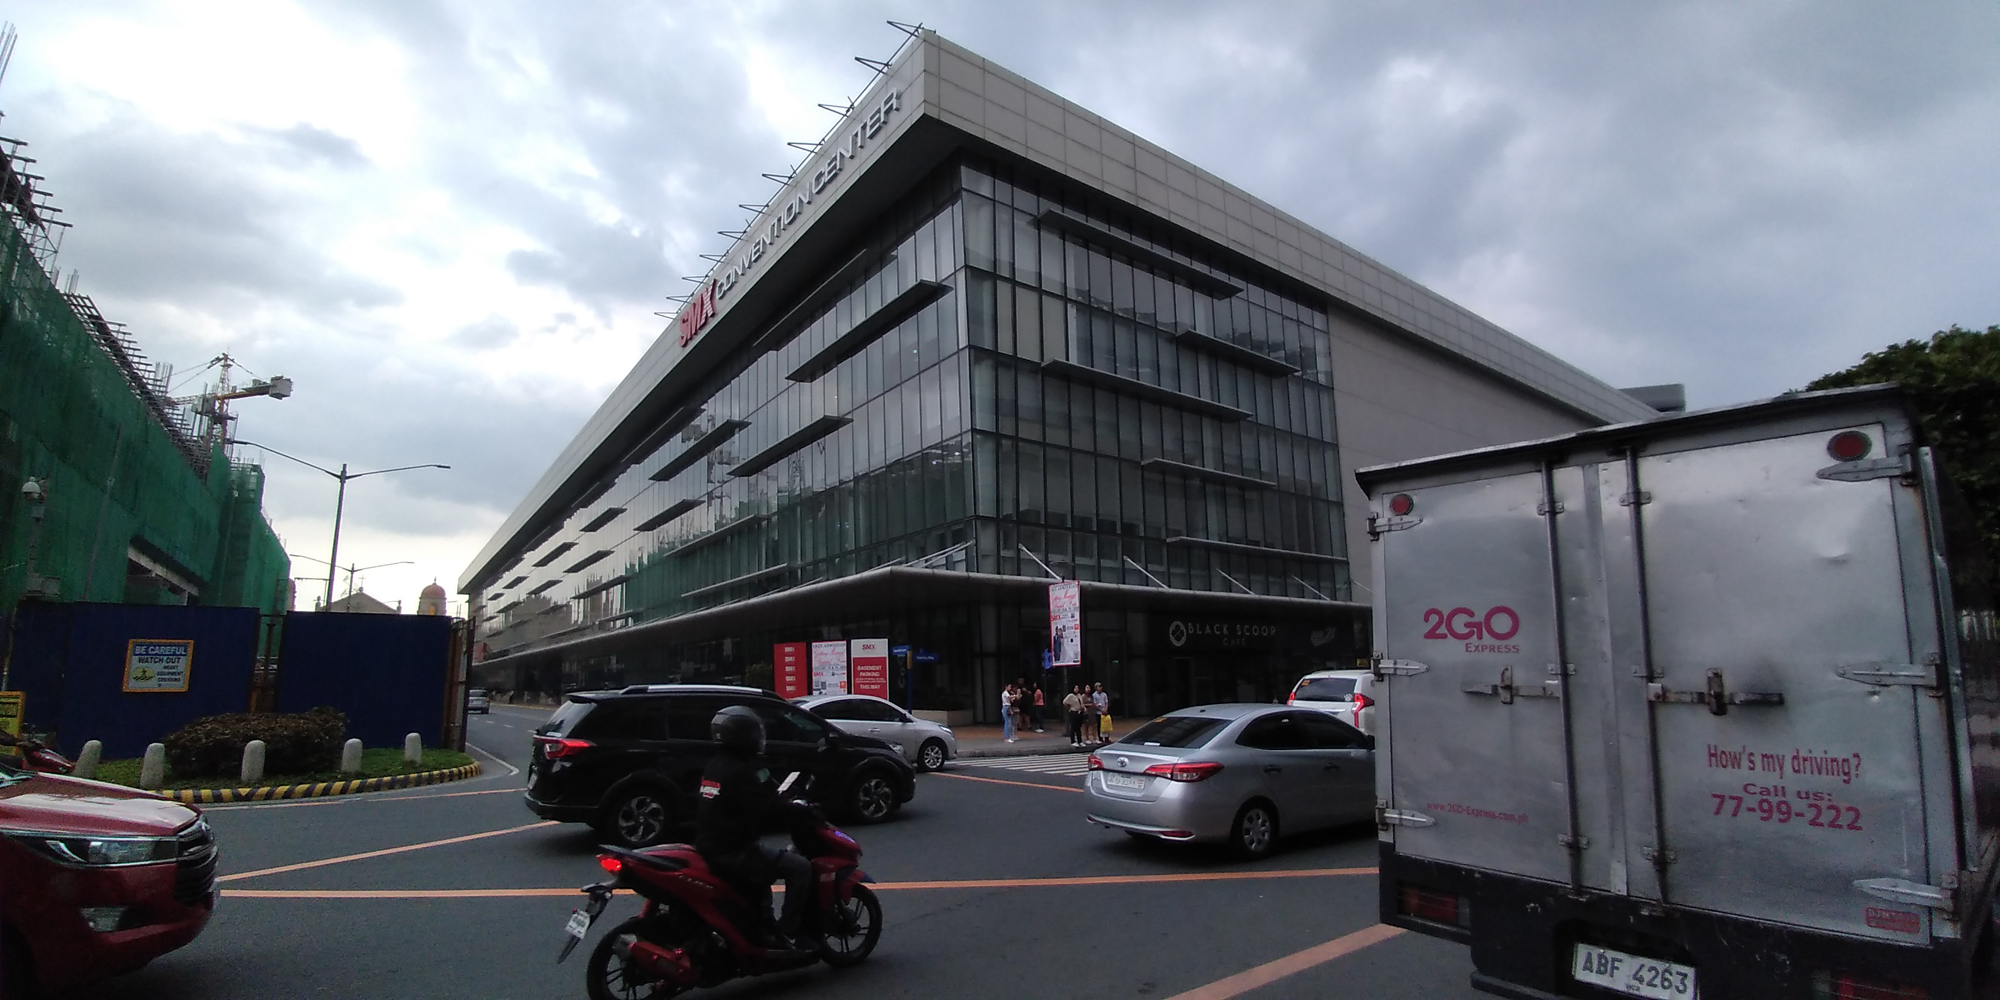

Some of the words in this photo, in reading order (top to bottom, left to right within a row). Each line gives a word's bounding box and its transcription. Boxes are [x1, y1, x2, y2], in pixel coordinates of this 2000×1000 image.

[678, 278, 718, 347] SMX
[716, 182, 812, 300] CONVENTION
[811, 87, 901, 196] CENTER
[1187, 622, 1229, 635] BLACK
[1236, 624, 1276, 636] SCOOP
[1423, 605, 1520, 641] 2GO
[135, 645, 147, 654] BE
[148, 646, 187, 655] CAREFUL
[138, 656, 164, 664] WATCH
[166, 656, 181, 664] OUT
[1707, 744, 1756, 771] How's
[1760, 752, 1786, 779] my
[1791, 748, 1862, 784] driving?
[1743, 783, 1786, 797] Call
[1796, 790, 1832, 802] us:
[1711, 793, 1863, 831] 77-99-222
[1582, 951, 1623, 978] ABF
[1631, 963, 1688, 995] 4263
